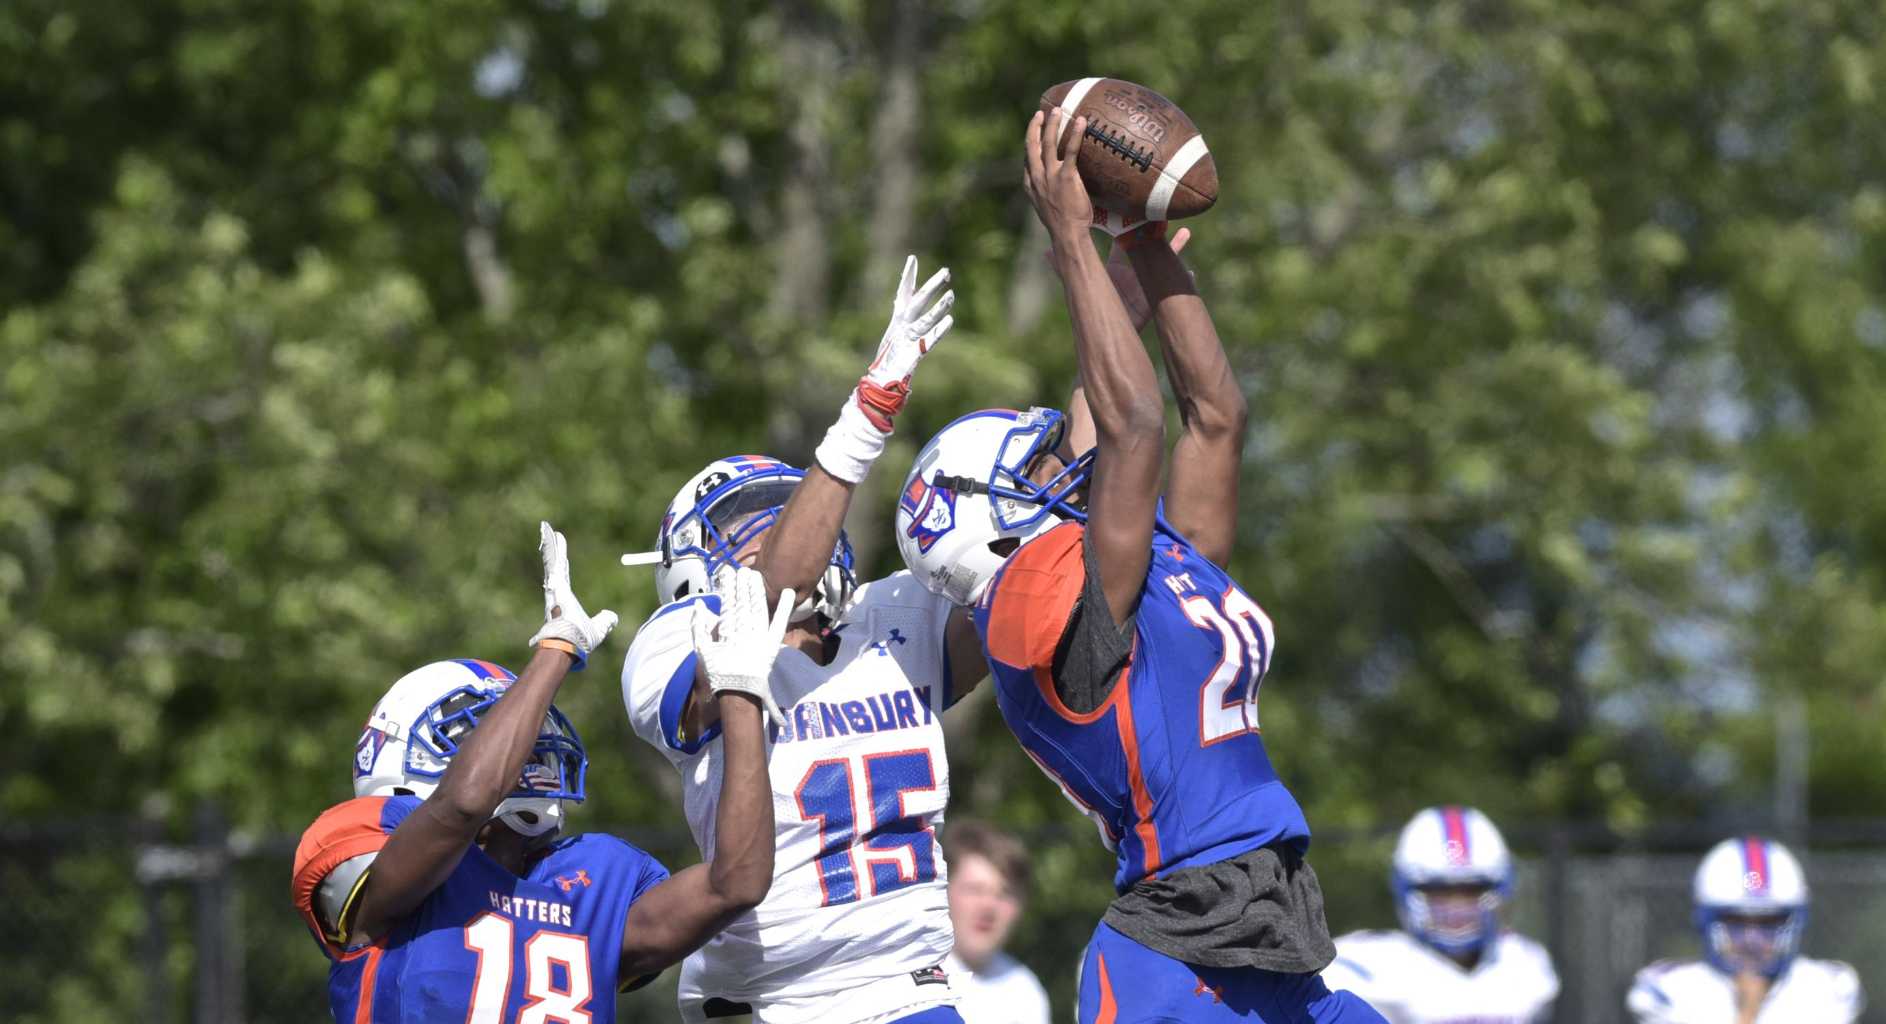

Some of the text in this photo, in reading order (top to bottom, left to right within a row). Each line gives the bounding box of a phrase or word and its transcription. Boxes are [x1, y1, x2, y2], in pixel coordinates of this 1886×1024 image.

[1103, 95, 1165, 142] Wilson
[1180, 582, 1276, 748] 20
[769, 685, 932, 744] DANBURY
[793, 747, 937, 908] 15
[489, 890, 571, 929] HATTERS
